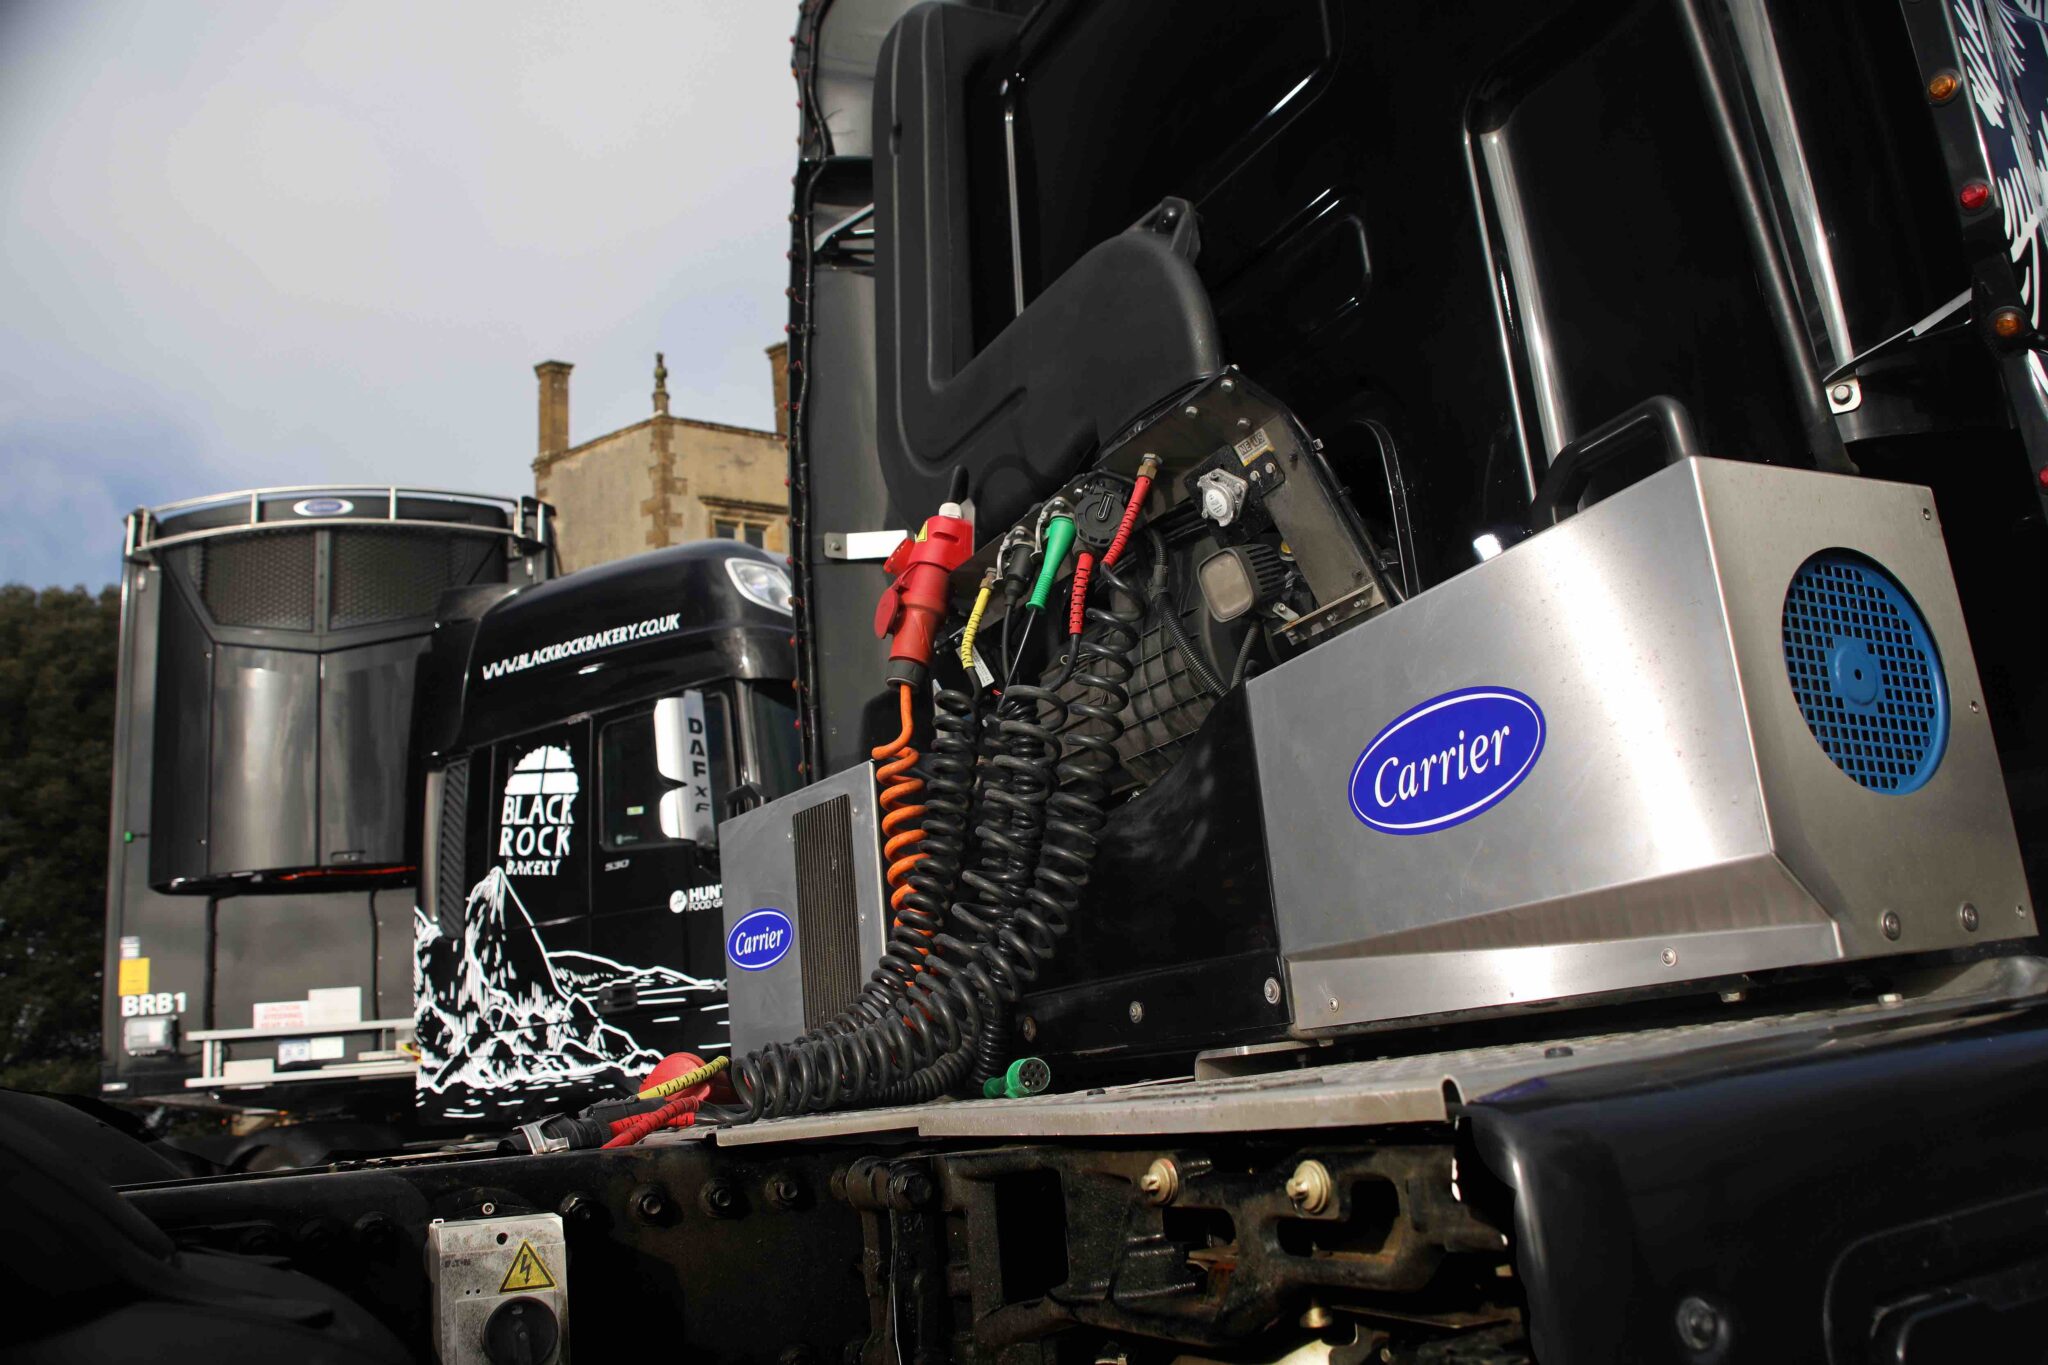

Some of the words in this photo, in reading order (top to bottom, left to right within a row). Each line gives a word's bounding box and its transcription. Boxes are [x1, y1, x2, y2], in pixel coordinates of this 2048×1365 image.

[1238, 432, 1265, 455] NEUS
[482, 613, 680, 680] WWW.BLACKROCKBAKERY.CO.UK
[687, 717, 707, 777] DAF
[1374, 725, 1510, 808] Carrier
[501, 794, 576, 825] BLACK
[695, 785, 710, 813] XF
[499, 826, 571, 857] ROCK
[505, 859, 562, 876] BAKERY
[605, 859, 630, 871] 530
[688, 899, 712, 912] FOOD
[735, 927, 784, 956] Carrier
[121, 992, 187, 1017] BRB1
